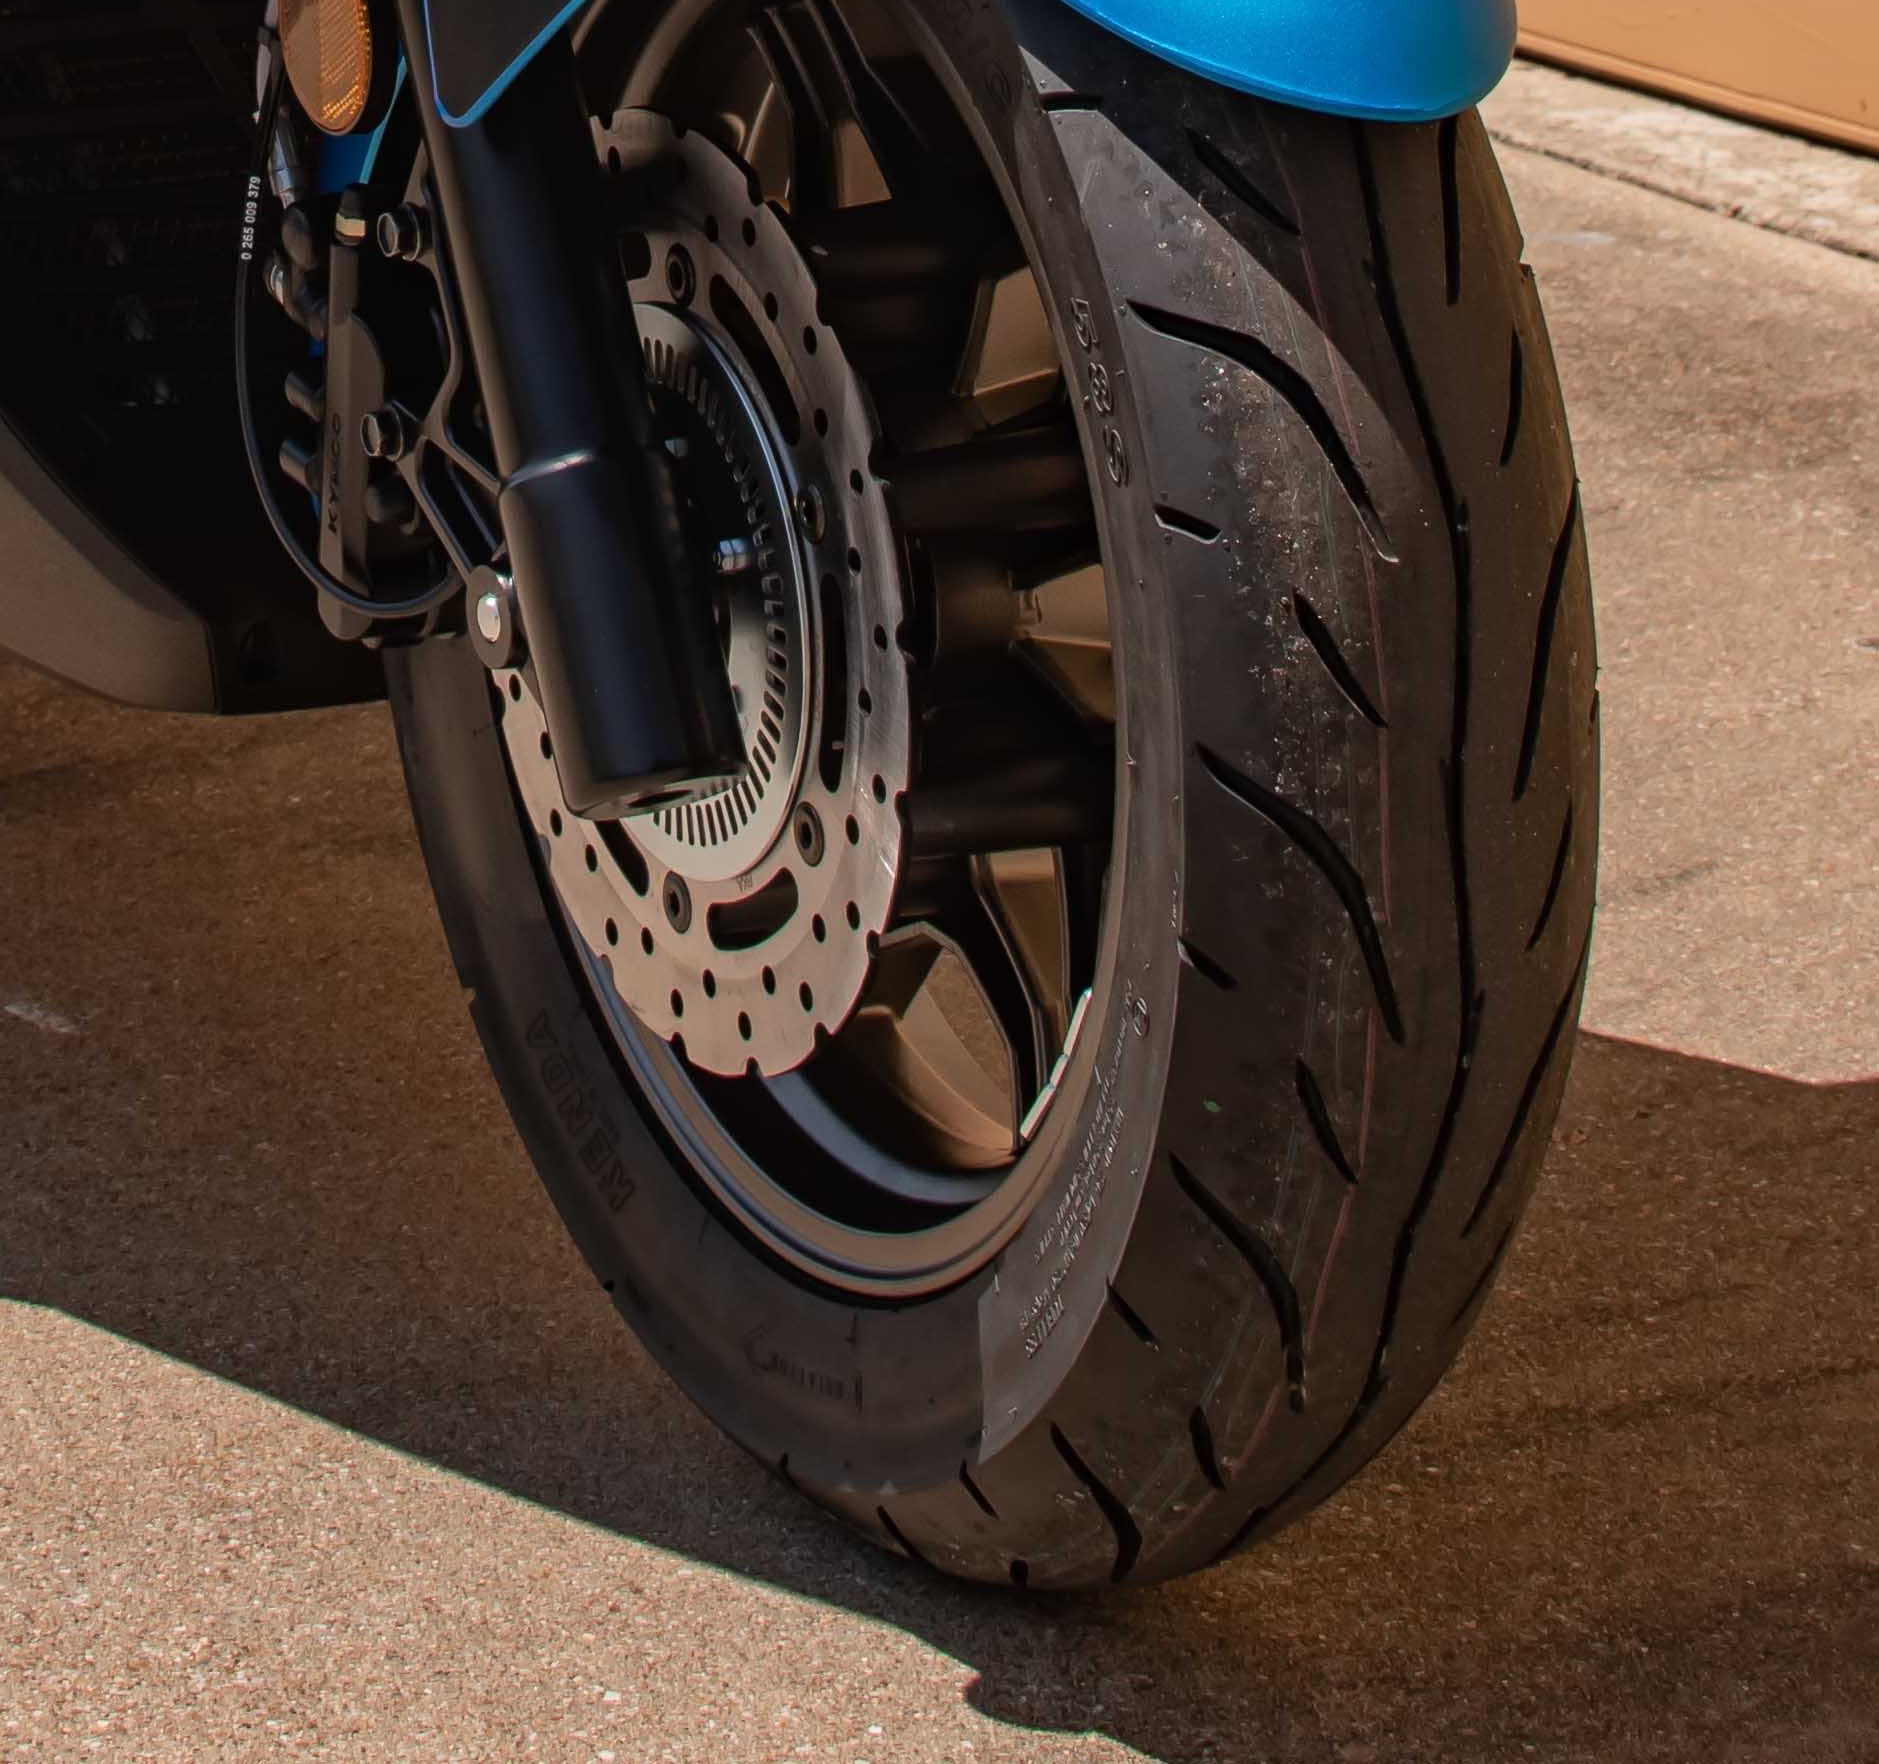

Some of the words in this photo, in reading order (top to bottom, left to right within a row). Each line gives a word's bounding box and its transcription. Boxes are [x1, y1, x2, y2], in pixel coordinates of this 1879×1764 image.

[247, 175, 261, 198] 379
[244, 201, 258, 223] 009
[242, 226, 255, 249] 265
[241, 252, 253, 260] 0
